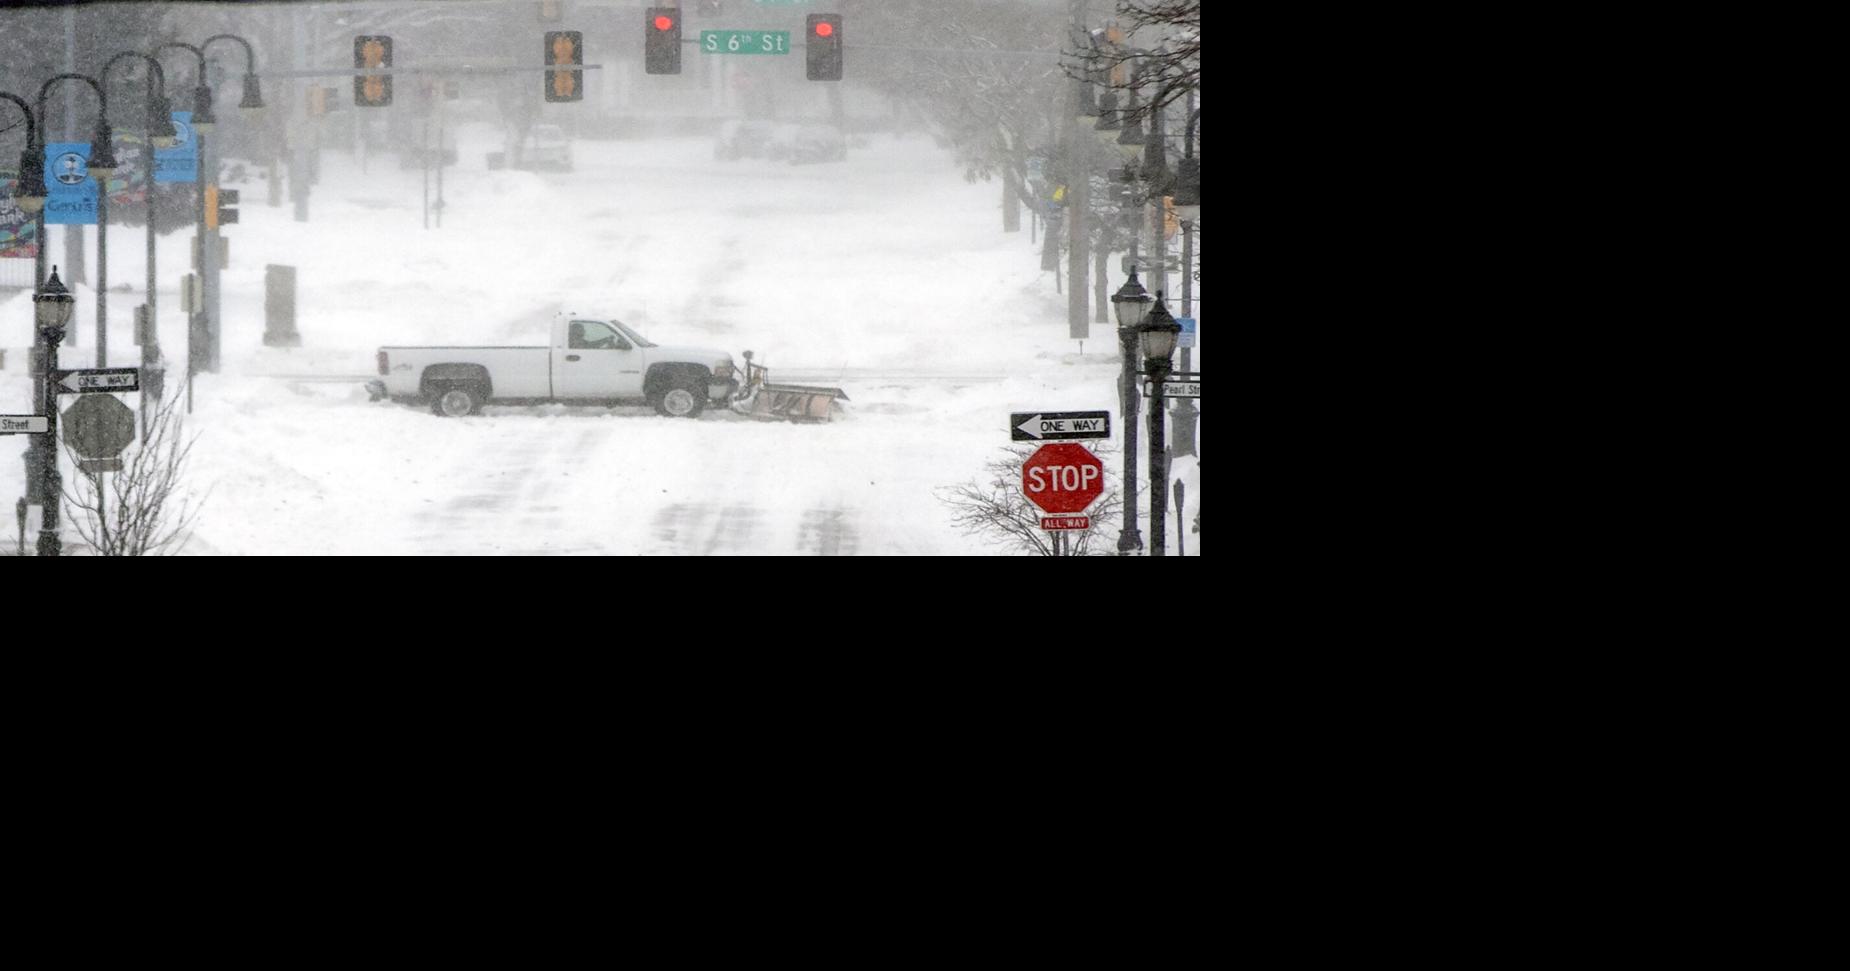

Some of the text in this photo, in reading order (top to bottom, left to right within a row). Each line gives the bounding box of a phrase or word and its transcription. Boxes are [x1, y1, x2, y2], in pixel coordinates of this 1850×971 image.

[706, 34, 784, 51] S 6th St
[79, 375, 130, 387] ONE WAY
[1163, 384, 1185, 395] Pearl
[2, 419, 29, 430] Street
[1041, 419, 1100, 432] ONE WAY
[1028, 464, 1099, 493] STOP
[1044, 518, 1086, 528] ALL WAY
